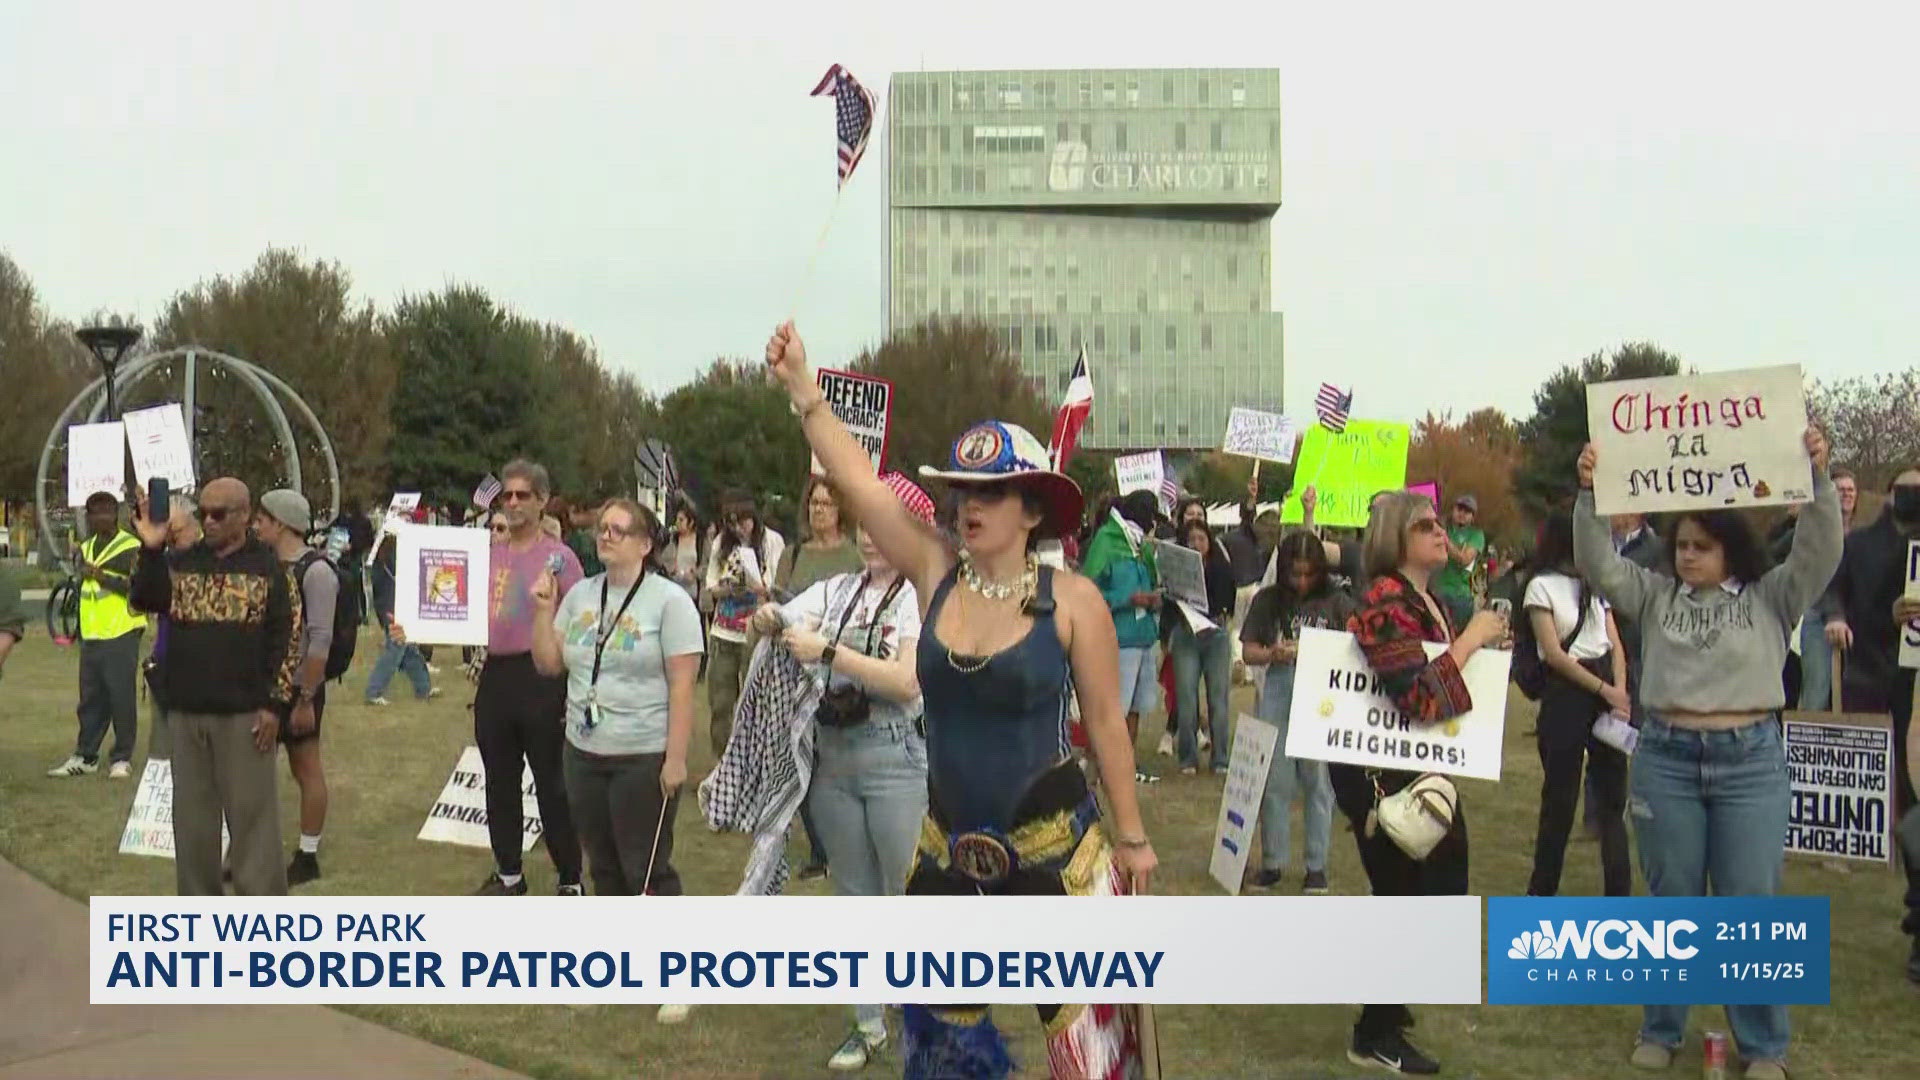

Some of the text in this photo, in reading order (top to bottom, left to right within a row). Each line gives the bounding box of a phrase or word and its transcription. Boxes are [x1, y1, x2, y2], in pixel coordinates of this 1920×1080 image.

[1092, 163, 1269, 188] CHARLOTTE
[821, 374, 886, 412] DEFEND
[831, 402, 884, 431] MOCRACY:
[1612, 392, 1766, 434] Chinga
[1627, 462, 1753, 496] Migra
[1366, 706, 1411, 732] OUR
[1326, 727, 1466, 767] NEIGHBORS!
[1786, 744, 1886, 772] BILLIONAIRES!
[453, 770, 482, 789] WE
[1811, 768, 1856, 788] DEFEAT
[1858, 774, 1886, 791] CAN
[431, 802, 541, 834] IMMIGTS
[1790, 790, 1885, 833] UNITED
[1785, 827, 1885, 859] THE PEOPLE
